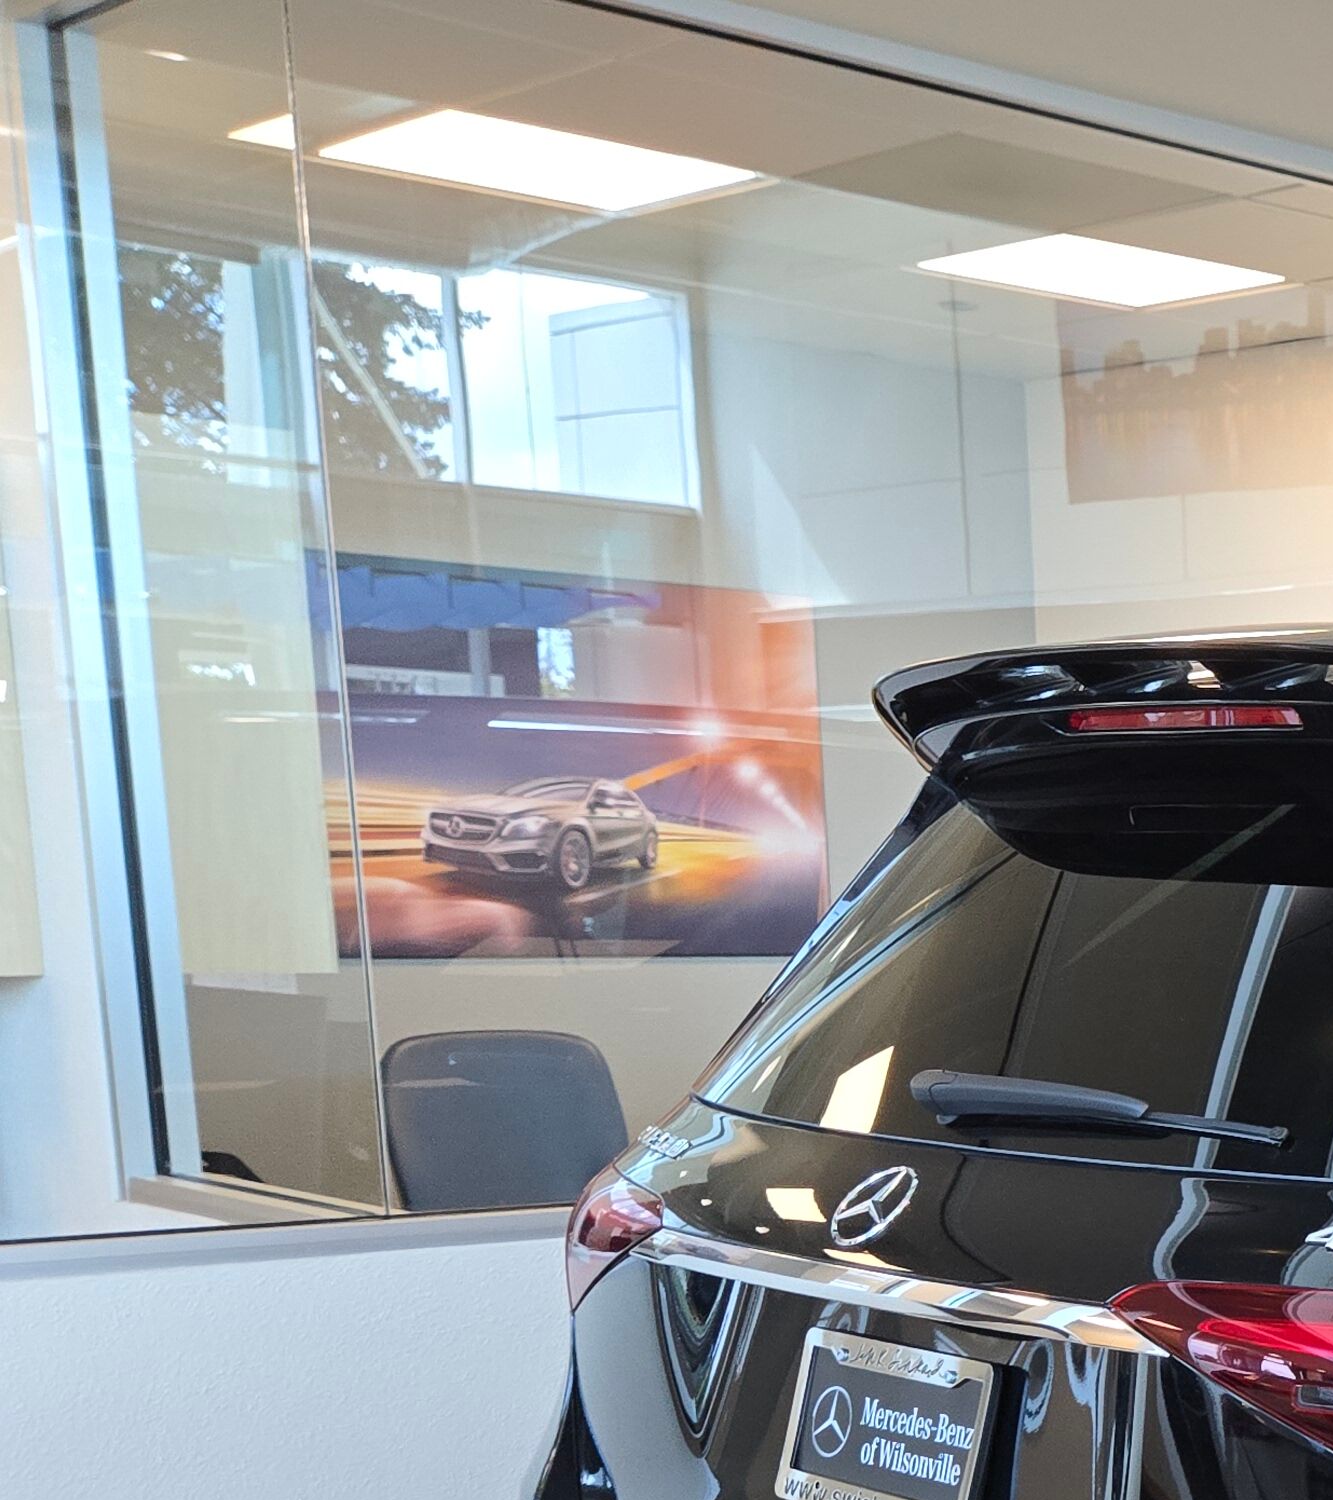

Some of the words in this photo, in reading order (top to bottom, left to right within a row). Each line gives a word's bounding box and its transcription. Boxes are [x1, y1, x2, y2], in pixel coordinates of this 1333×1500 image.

[860, 1397, 975, 1449] Mercedes-Benz
[860, 1437, 880, 1465] of
[879, 1438, 961, 1486] Wilsonville
